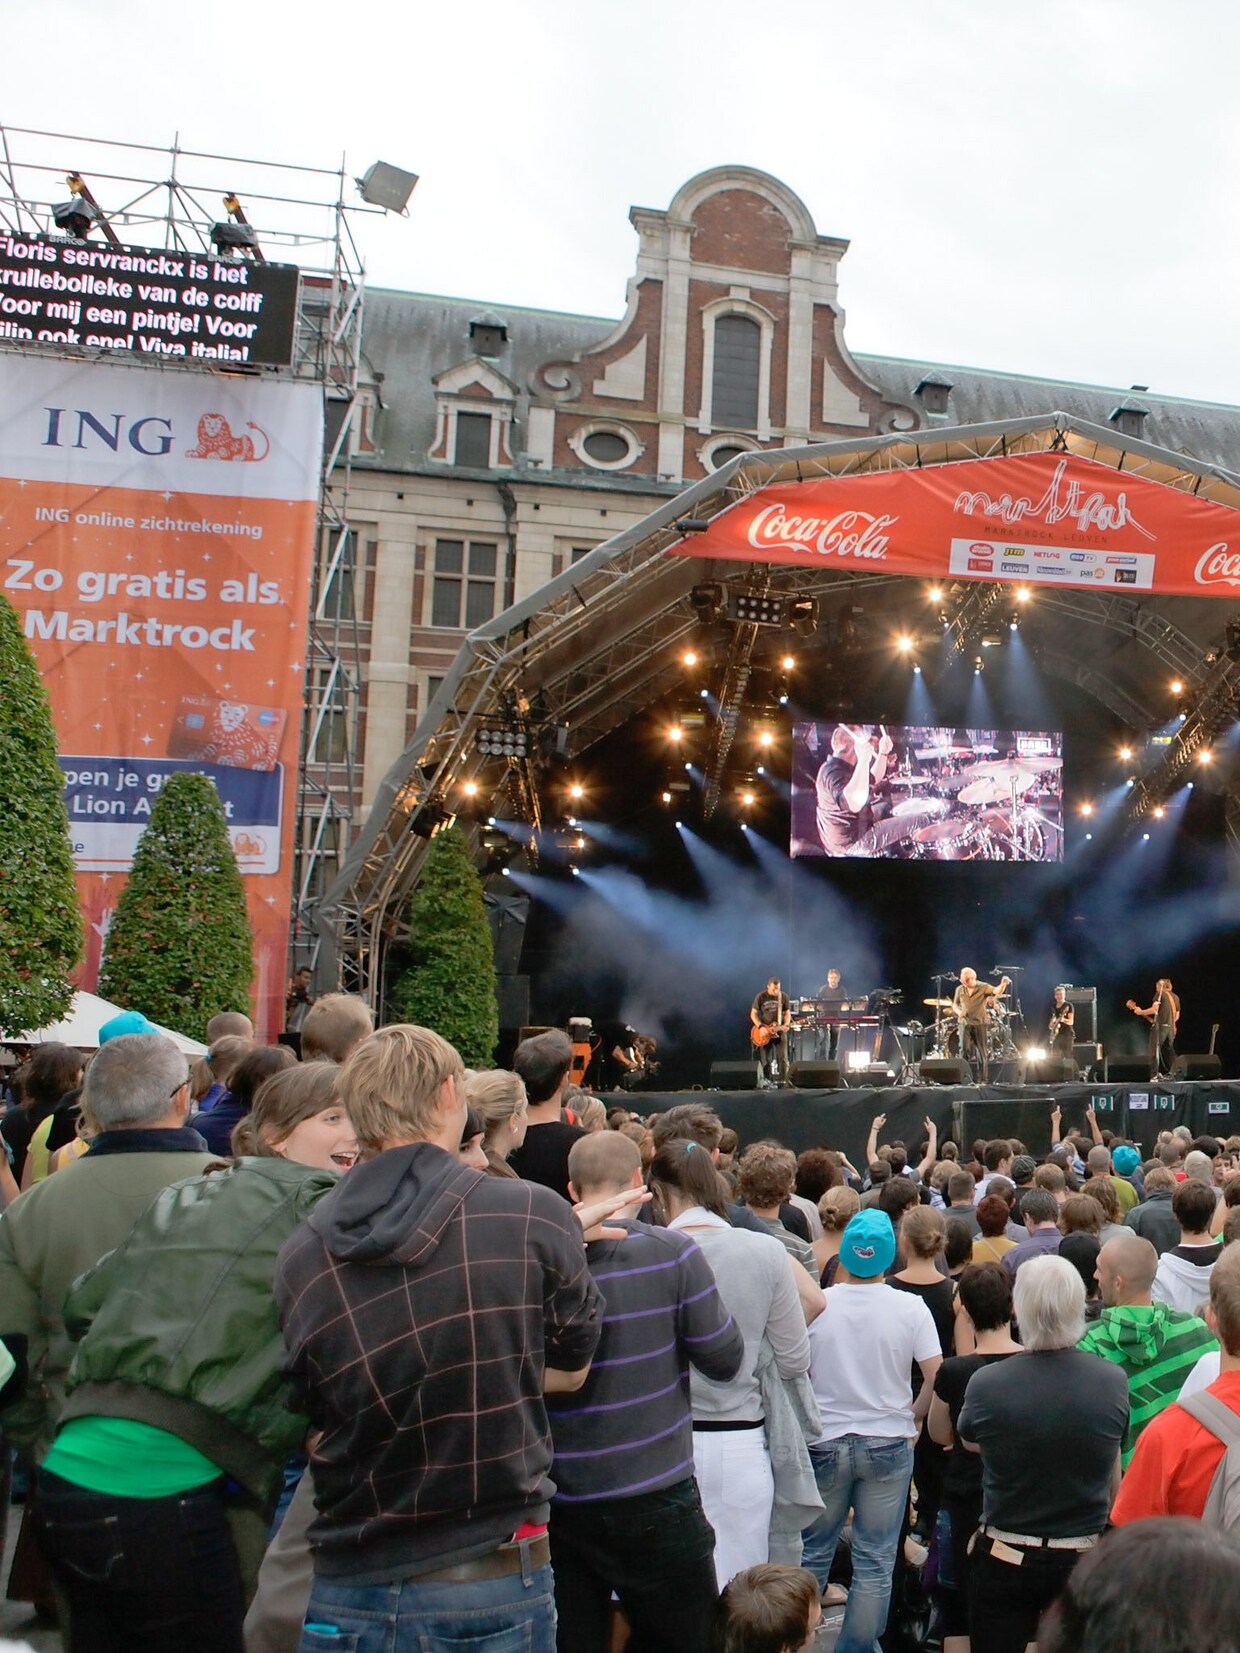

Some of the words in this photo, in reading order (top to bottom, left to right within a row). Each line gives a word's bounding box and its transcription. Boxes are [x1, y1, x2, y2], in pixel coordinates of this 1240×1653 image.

[0, 237, 57, 262] Floris
[62, 248, 184, 277] servranckx
[189, 259, 209, 280] is
[213, 263, 248, 285] het
[0, 267, 133, 298] rullebolleke
[137, 284, 177, 304] van
[182, 286, 209, 307] de
[213, 291, 263, 313] colff
[0, 293, 42, 315] oor
[46, 301, 82, 325] mij
[86, 306, 127, 326] een
[131, 309, 200, 336] pintje!
[205, 315, 257, 339] Voor
[38, 328, 81, 344] ook
[138, 335, 186, 356] Viva
[40, 407, 176, 456] ING
[35, 507, 70, 523] ING
[75, 511, 135, 529] online
[140, 515, 263, 540] zichtrekening
[748, 503, 900, 561] Coca-Cola
[4, 558, 63, 592] Zo
[77, 569, 207, 602] gratis
[219, 572, 280, 605] als
[1002, 563, 1028, 573] LEUVEN
[24, 609, 256, 651] Marktrock
[64, 771, 109, 790] pen
[115, 768, 140, 792] je
[73, 794, 126, 814] Lion
